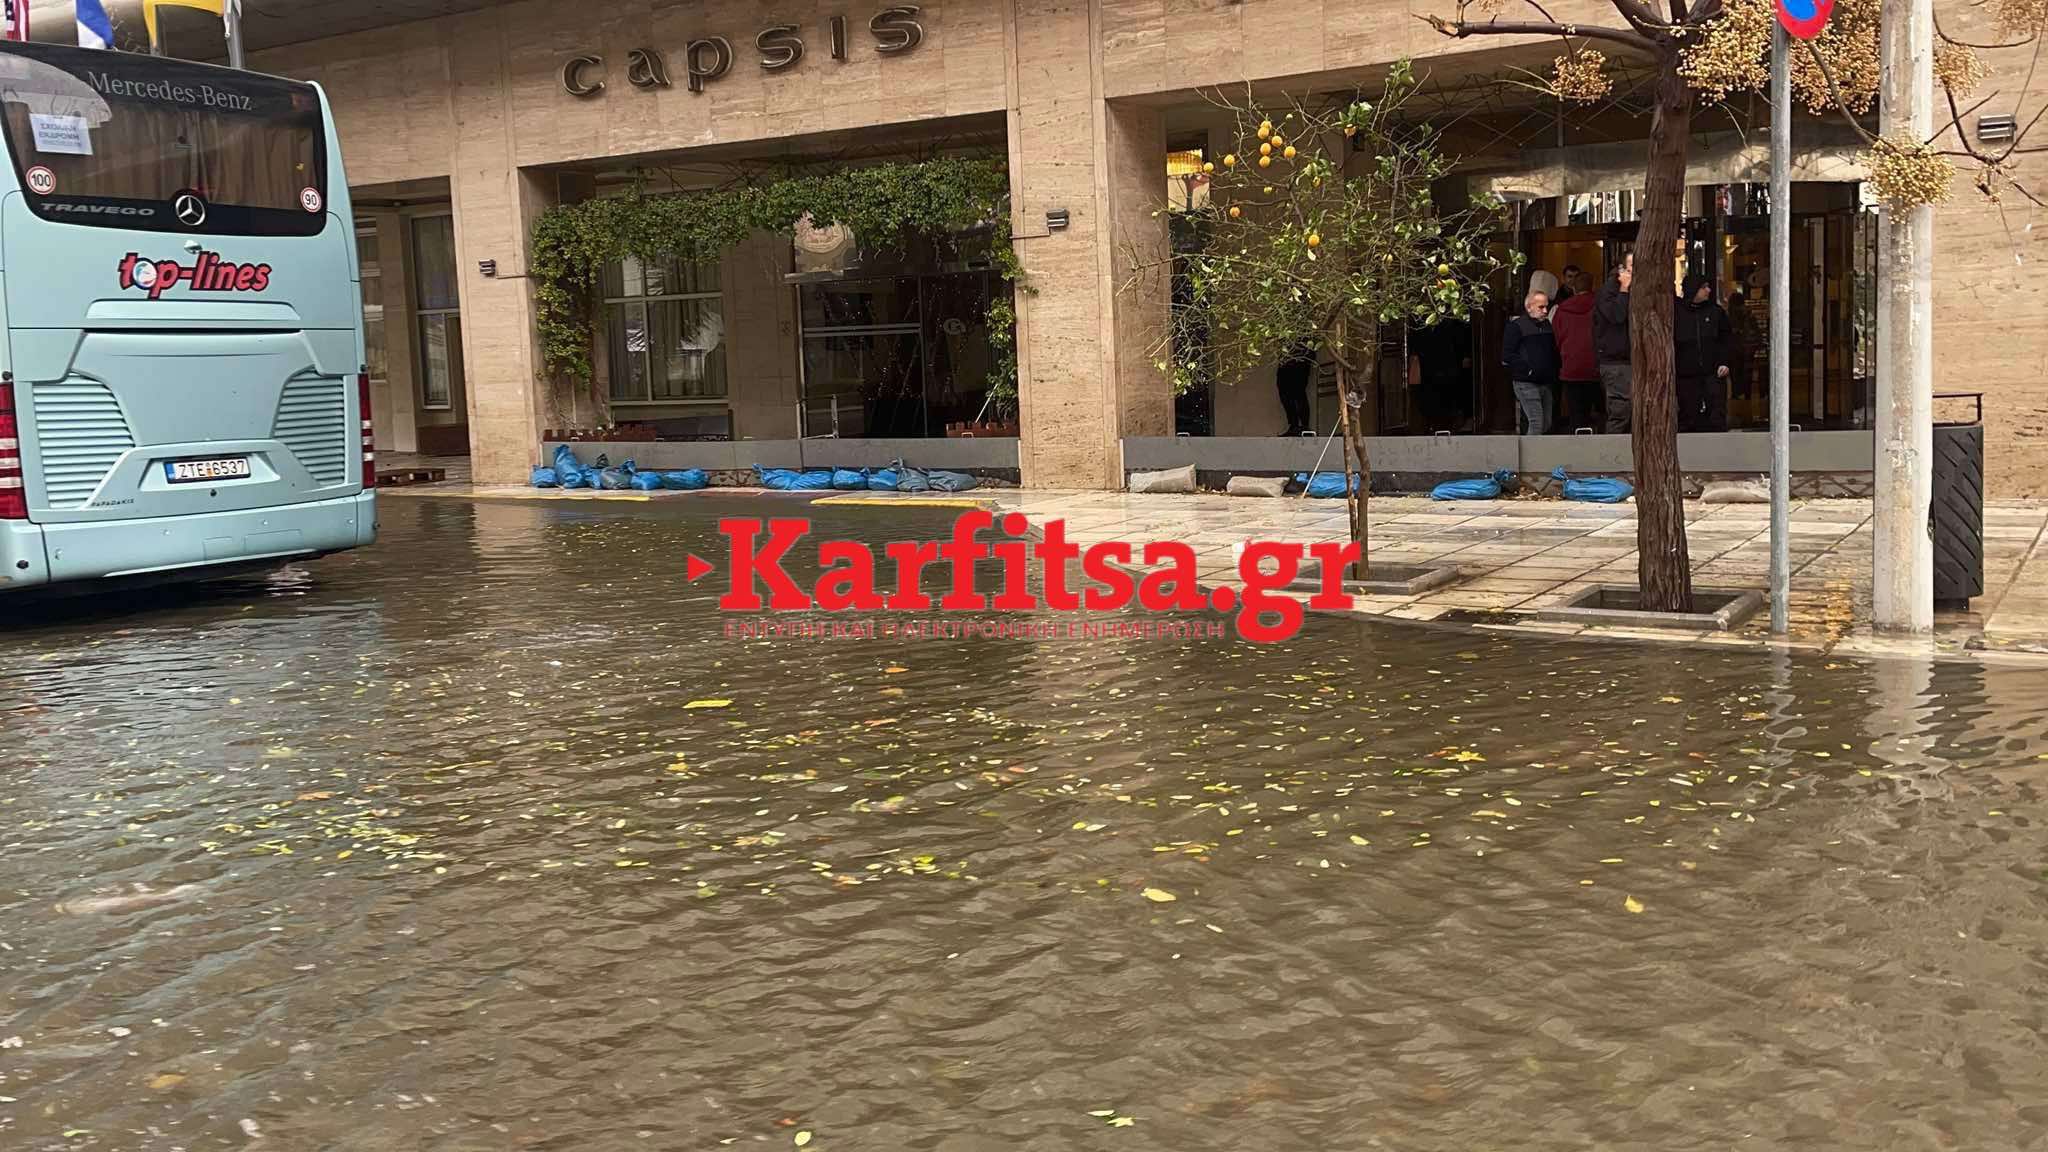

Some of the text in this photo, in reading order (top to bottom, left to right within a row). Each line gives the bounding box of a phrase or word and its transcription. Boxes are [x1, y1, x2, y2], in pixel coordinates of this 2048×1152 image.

[561, 4, 925, 97] capsis
[87, 71, 252, 111] Mercedes-Benz
[31, 173, 52, 187] 100
[40, 202, 155, 216] TRAVEGO
[305, 193, 317, 206] 90
[118, 250, 272, 300] top-lines
